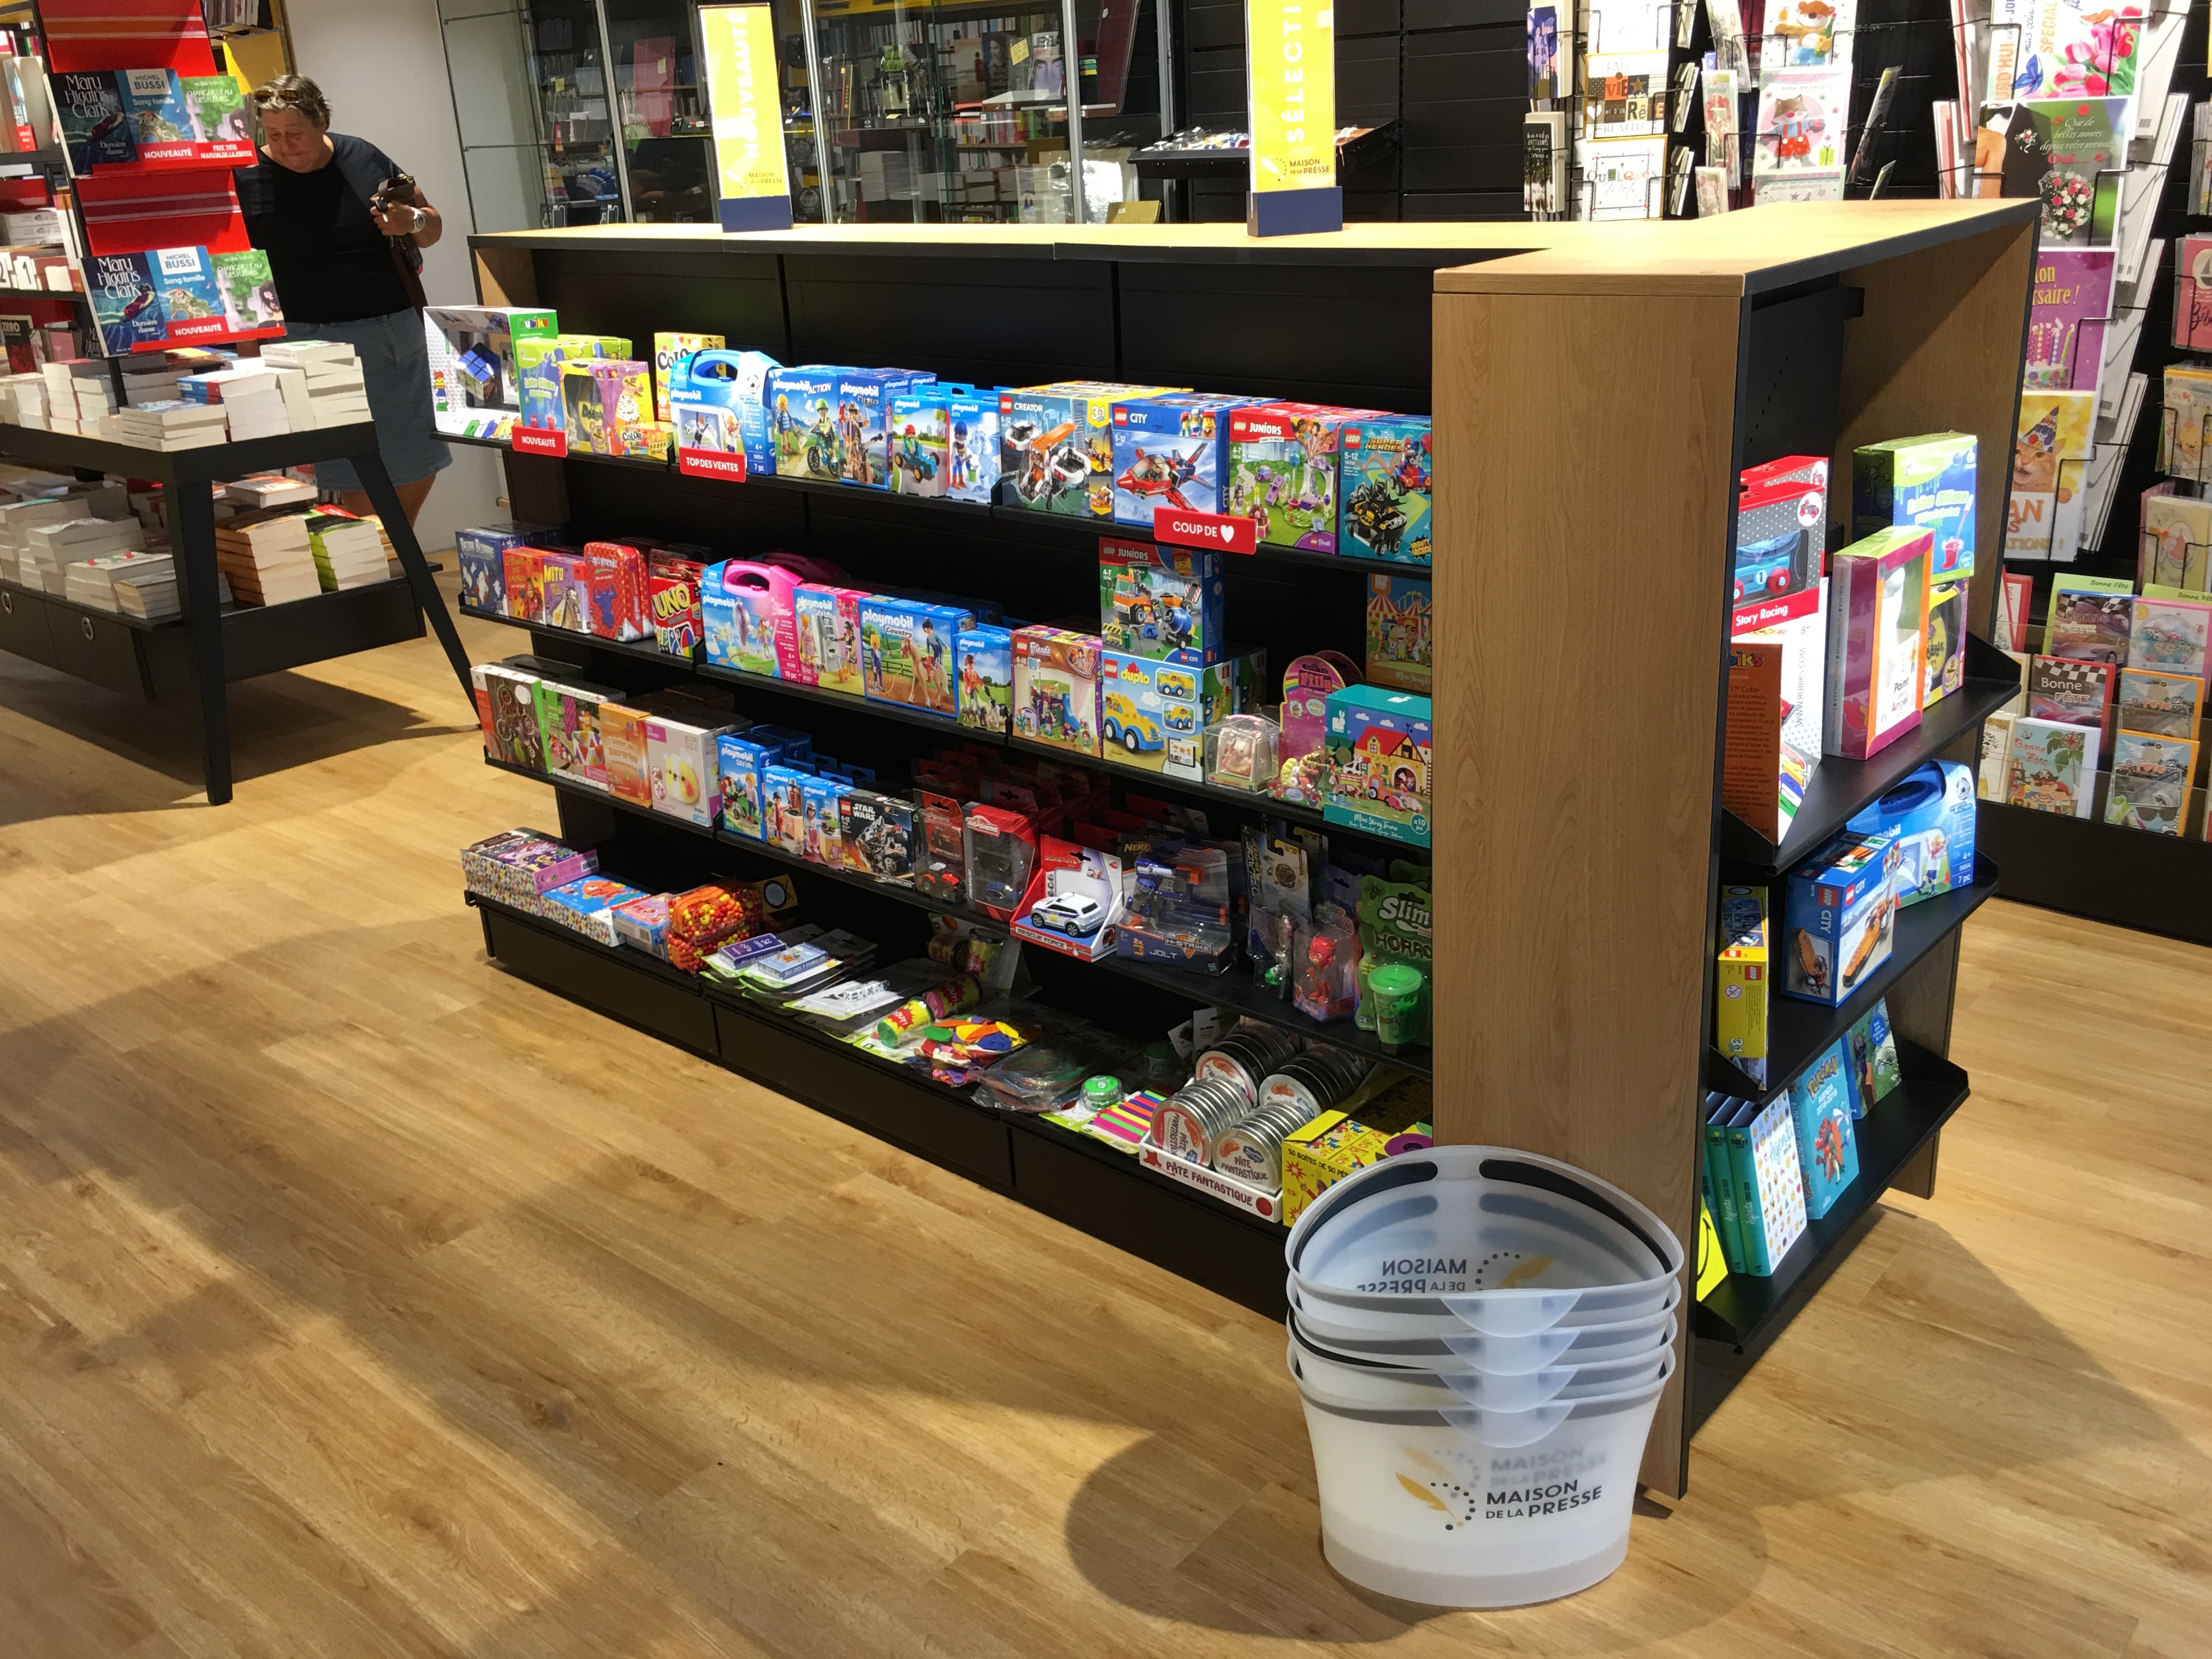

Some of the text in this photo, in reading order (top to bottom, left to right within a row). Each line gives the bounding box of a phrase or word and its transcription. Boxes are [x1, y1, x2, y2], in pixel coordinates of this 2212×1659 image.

[65, 75, 101, 91] Mary
[134, 81, 165, 90] BUSSI
[727, 10, 760, 159] NOUVEAUTÉ
[64, 89, 110, 105] Higgins
[133, 98, 151, 106] Sang
[71, 103, 110, 119] Clark
[2083, 117, 2095, 127] de
[2054, 128, 2103, 139] belles années
[145, 148, 193, 159] NOUVEAUTÉ
[2039, 140, 2115, 155] depuis votre premier
[1304, 166, 1330, 174] PRESSE
[98, 257, 133, 273] Mary
[165, 259, 195, 269] BUSSI
[97, 272, 140, 286] Higgins
[164, 275, 205, 285] Sang famille
[105, 284, 142, 300] Clark
[132, 319, 157, 328] Dernière
[175, 323, 222, 336] NOUVEAUTÉ
[773, 379, 810, 392] playmobil
[885, 379, 909, 390] playmobil
[911, 376, 935, 386] playmobil
[670, 388, 702, 401] playmobil
[808, 382, 831, 394] ACTION
[840, 382, 879, 397] playmobil
[894, 399, 920, 409] playmobil
[952, 404, 978, 413] playmobil
[1014, 402, 1043, 413] CREATOR
[1115, 413, 1148, 425] LEGO CITY
[1234, 421, 1282, 435] LEGO JUNIORS
[522, 436, 556, 448] NOUVEAUTÉ
[1115, 435, 1126, 443] 5-12
[1346, 435, 1361, 443] LEGO
[1233, 446, 1242, 454] 4-7
[1364, 444, 1403, 453] HEROES
[1344, 452, 1358, 460] 5-12
[686, 457, 738, 472] TOP DES VENTES
[1173, 521, 1217, 537] COUP DE
[1103, 547, 1149, 560] LEGO JUNIORS
[544, 565, 564, 583] MITO
[1758, 569, 1764, 583] 1
[2114, 581, 2129, 589] Fête
[652, 584, 691, 619] UNO
[862, 608, 913, 629] playmobil
[1735, 603, 1788, 626] Story Racing
[2066, 612, 2110, 623] Bonne
[885, 627, 913, 639] Country
[960, 638, 985, 648] playmobil
[1030, 641, 1051, 656] Friends
[1120, 669, 1150, 686] duplo
[1299, 671, 1331, 693] Filly
[1795, 647, 1805, 728] WWW.RUBIKS.COM
[1894, 678, 1909, 693] Paint
[2041, 678, 2083, 691] Bonne
[2054, 690, 2090, 704] FÊTE
[1892, 696, 1909, 713] Angel
[2014, 737, 2046, 753] Bonne
[721, 747, 753, 761] playmobil
[766, 772, 788, 782] playmobil
[804, 786, 827, 796] playmobil
[854, 803, 874, 814] STAR
[853, 810, 876, 822] WARS
[1354, 813, 1383, 829] Mini Story
[1413, 818, 1426, 826] x10
[1124, 843, 1151, 853] NERF
[1963, 852, 1971, 860] 4+
[1963, 874, 1971, 883] pc
[1855, 881, 1865, 894] CITY
[1823, 889, 1833, 905] LEGO
[1820, 909, 1833, 935] CITY
[1018, 928, 1066, 949] RESCUE FORCE
[1166, 937, 1211, 952] N-STRIKE
[1149, 951, 1177, 959] JOLT
[1818, 1084, 1833, 1104] AGENDA
[1769, 1124, 1795, 1165] Agenda
[1234, 1155, 1252, 1169] PÂTE
[1288, 1148, 1296, 1156] 50
[1296, 1152, 1317, 1165] BOÎTES
[1318, 1162, 1326, 1170] DE
[1221, 1163, 1268, 1181] FANTASTIQUE
[1166, 1161, 1253, 1206] PÂTE FANTASTIQUE
[1486, 1480, 1579, 1506] MAISON
[1486, 1485, 1603, 1519] DE LA PRESSE
